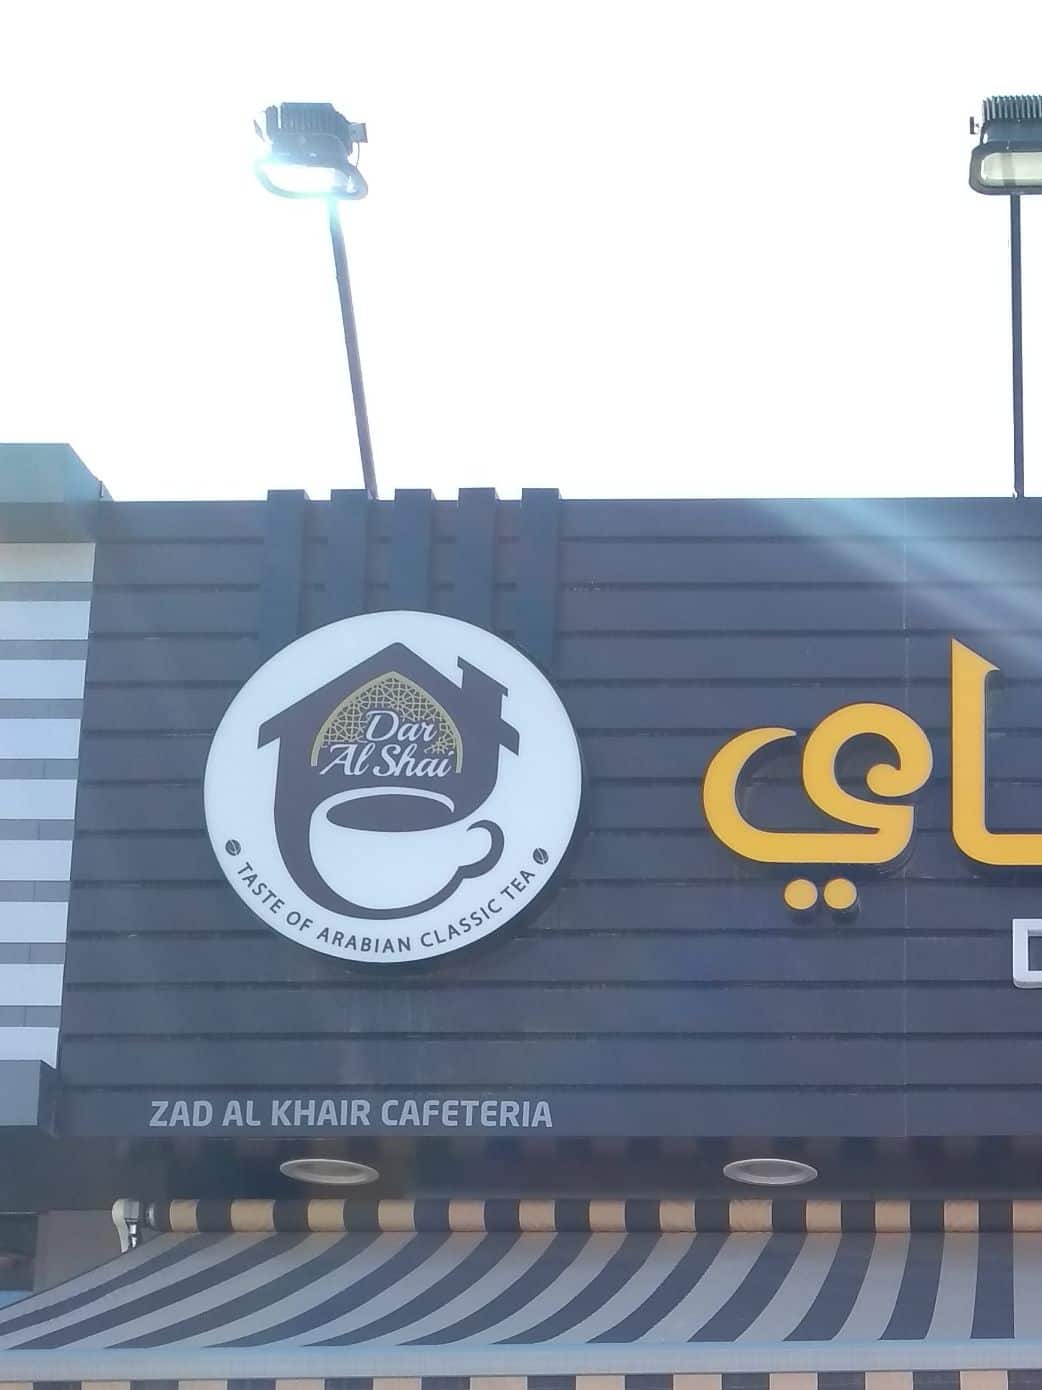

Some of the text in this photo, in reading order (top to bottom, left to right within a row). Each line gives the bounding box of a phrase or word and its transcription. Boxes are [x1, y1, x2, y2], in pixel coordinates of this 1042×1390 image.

[364, 710, 438, 743] Dar
[320, 741, 455, 777] Al Shai
[237, 862, 536, 954] TASTE OF ARABIAN CLASSIC TEA
[150, 1099, 553, 1127] ZAD AL KHAIR CAFETERIA
